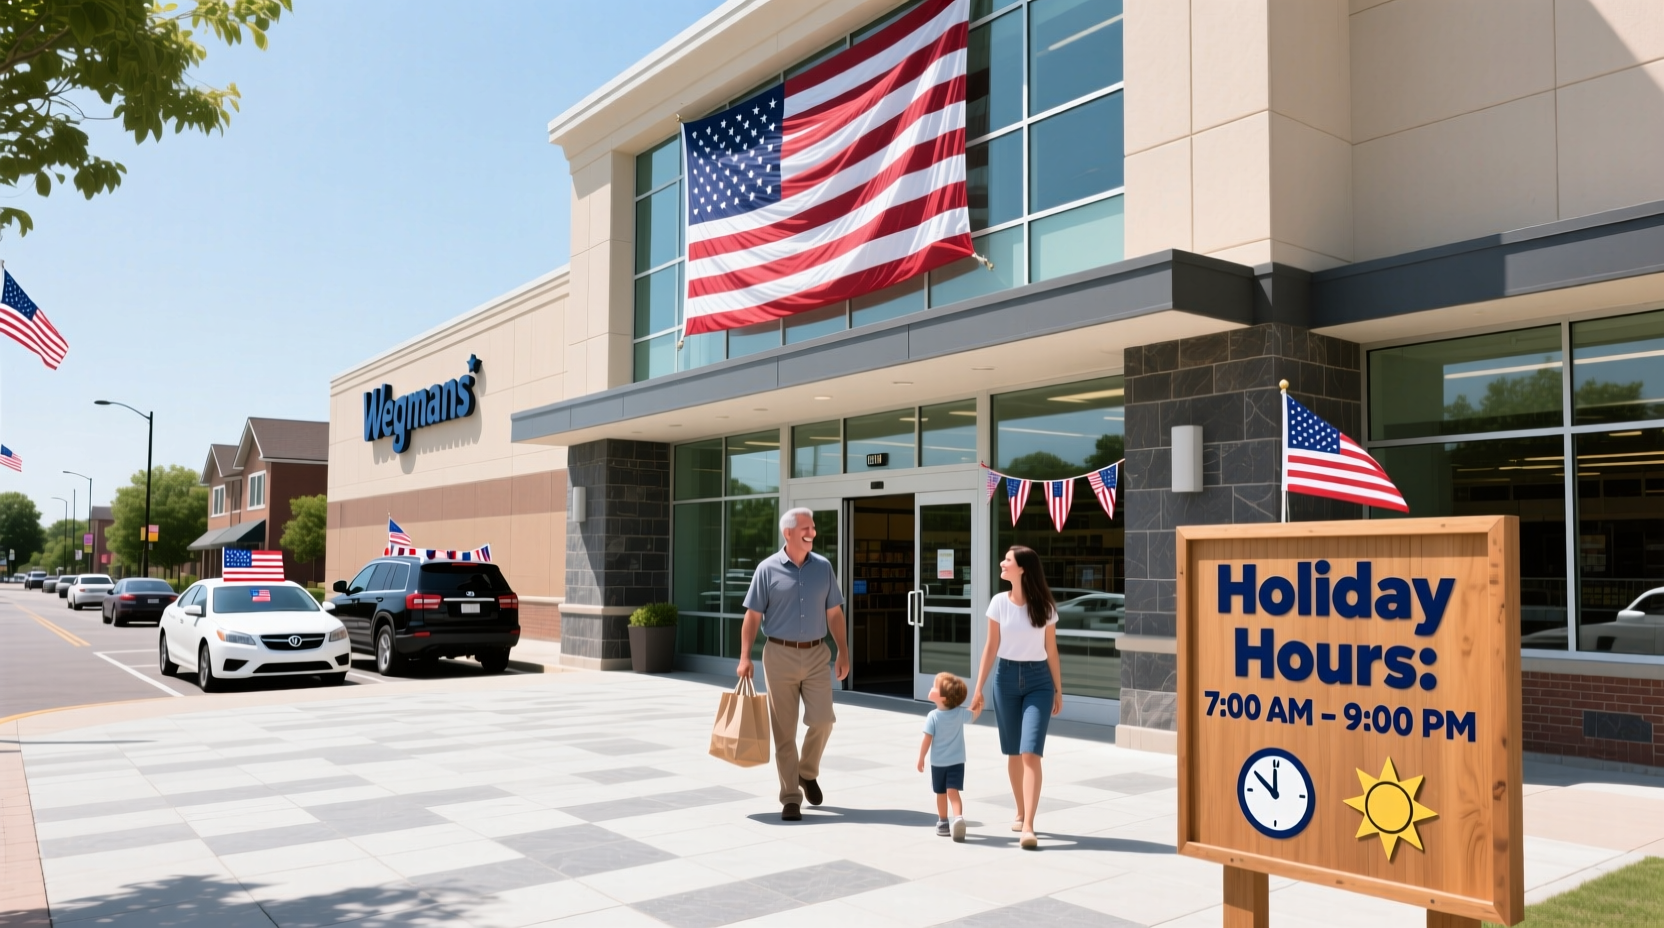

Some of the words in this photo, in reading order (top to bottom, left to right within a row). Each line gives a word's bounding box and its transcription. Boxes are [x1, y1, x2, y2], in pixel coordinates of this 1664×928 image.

[363, 374, 476, 454] Wegmans
[1217, 559, 1456, 636] Holiday
[1234, 627, 1437, 690] Hours:
[1204, 690, 1261, 720] 7:00
[1266, 697, 1313, 726] AM
[1343, 702, 1413, 736] 9:00
[1422, 709, 1476, 742] PM
